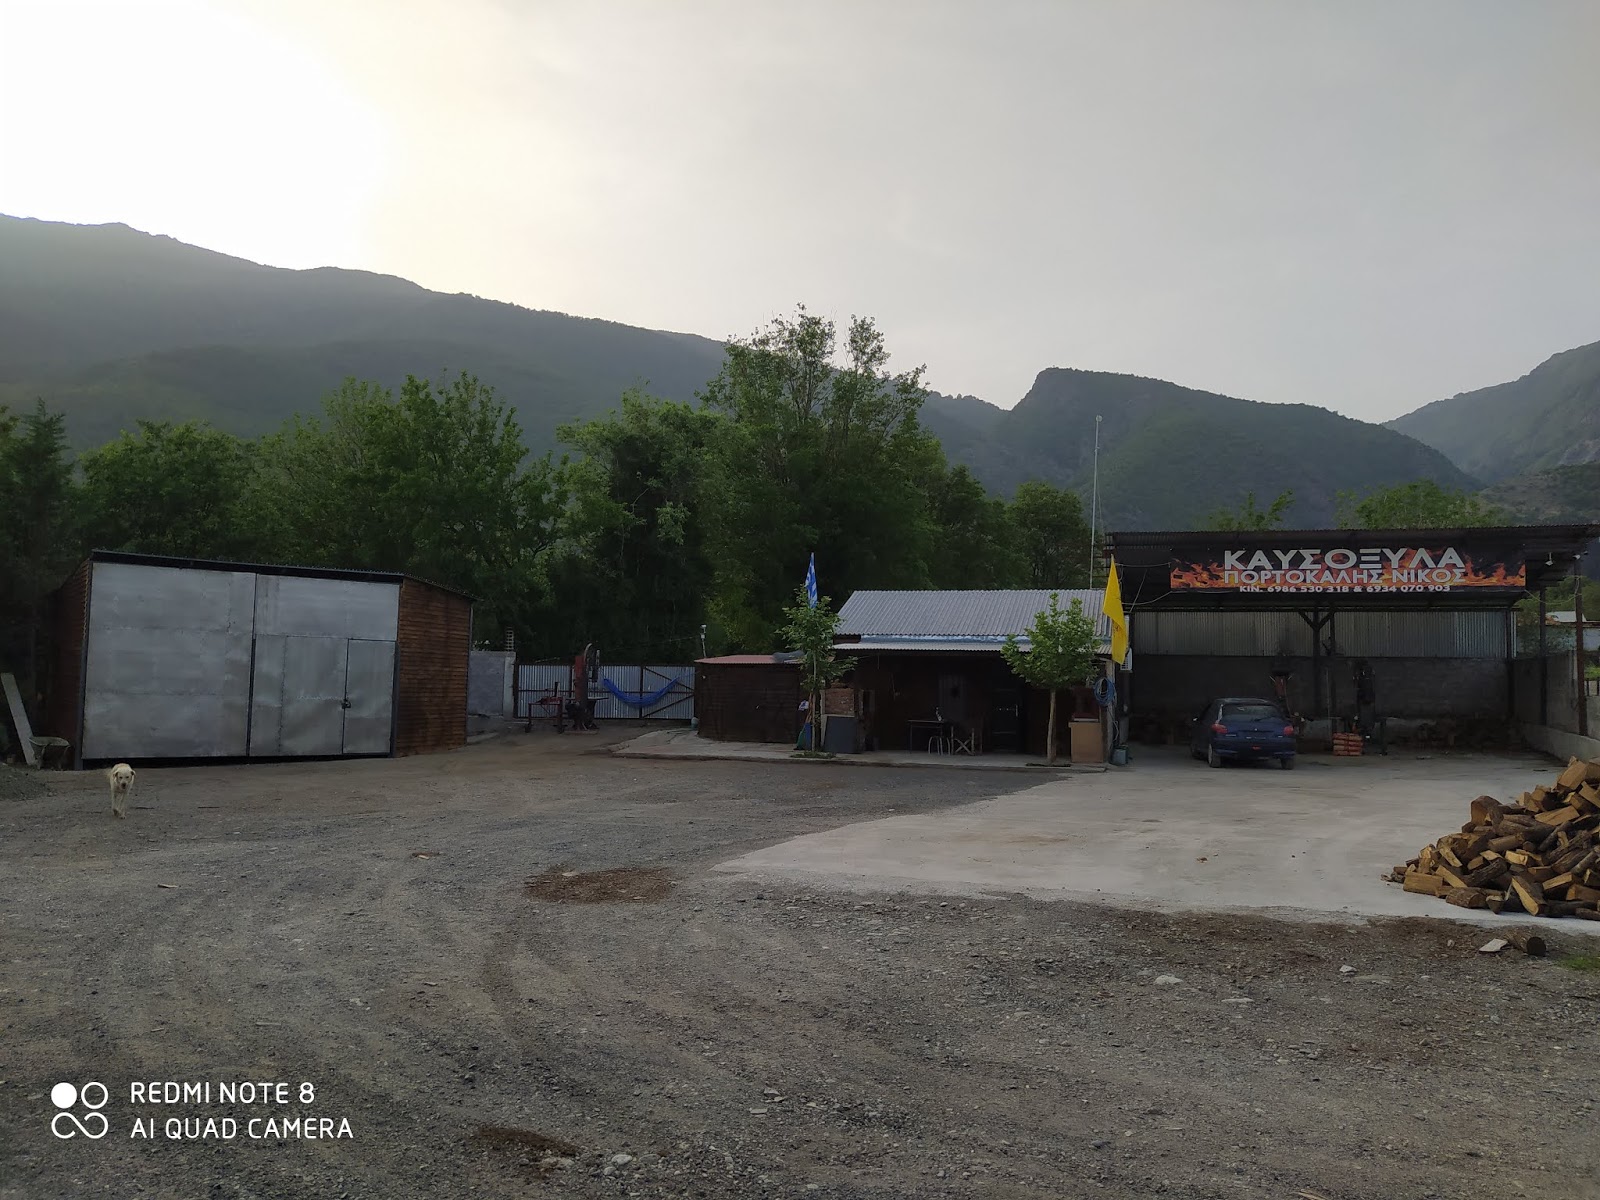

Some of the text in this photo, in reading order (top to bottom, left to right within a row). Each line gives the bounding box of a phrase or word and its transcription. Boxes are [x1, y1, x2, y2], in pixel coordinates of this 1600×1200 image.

[1224, 547, 1466, 570] ΚΑΥΣΟΞΥΛΑ
[1224, 568, 1466, 584] ΠΟΡΤΟΚΑΛΗΣ ΝΙΚΟΣ
[1267, 585, 1297, 593] 6986
[1300, 585, 1323, 593] 530
[1326, 585, 1349, 593] 318
[1366, 584, 1397, 592] 6934
[1400, 584, 1424, 592] 070
[1427, 584, 1451, 592] 903
